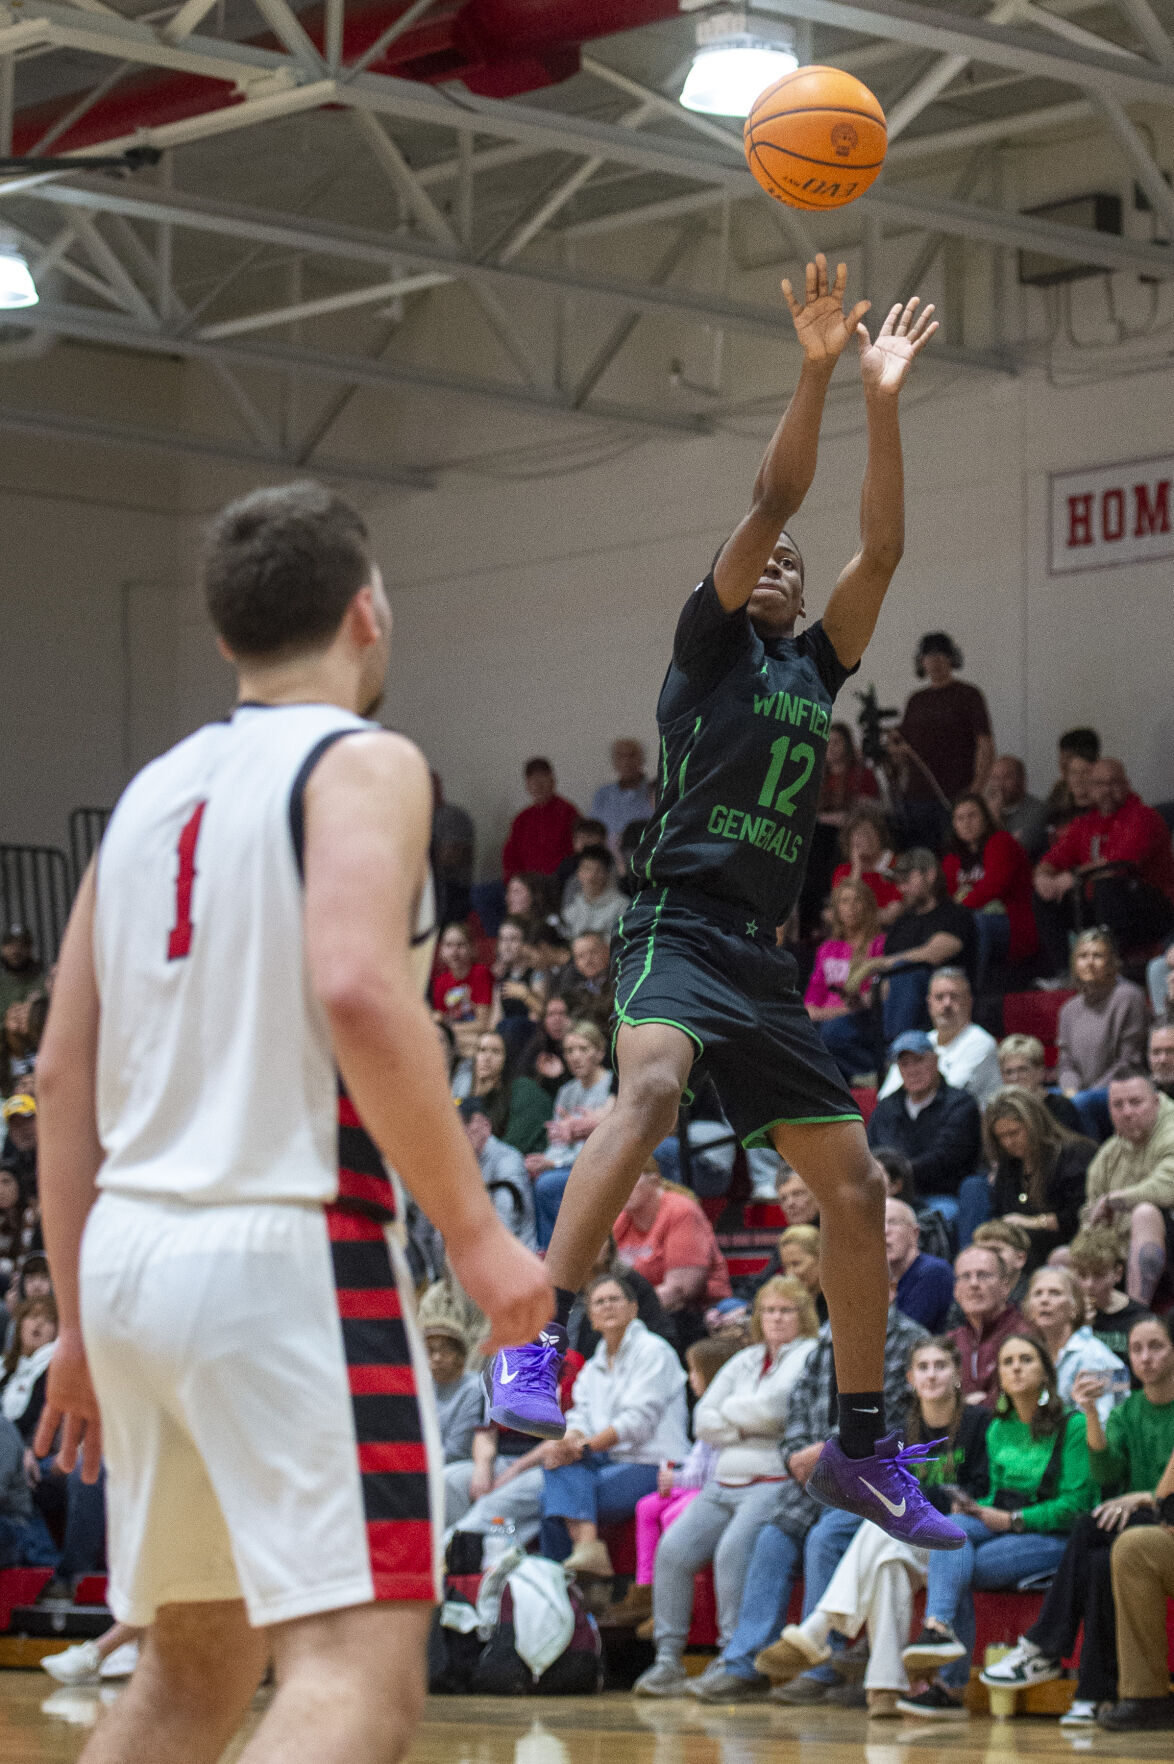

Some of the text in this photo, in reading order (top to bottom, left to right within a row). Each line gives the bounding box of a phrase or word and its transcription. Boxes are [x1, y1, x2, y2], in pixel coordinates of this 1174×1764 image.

[1066, 480, 1171, 548] HOM
[757, 735, 816, 818] 12
[706, 804, 803, 864] GENERALS
[165, 796, 208, 963] 1
